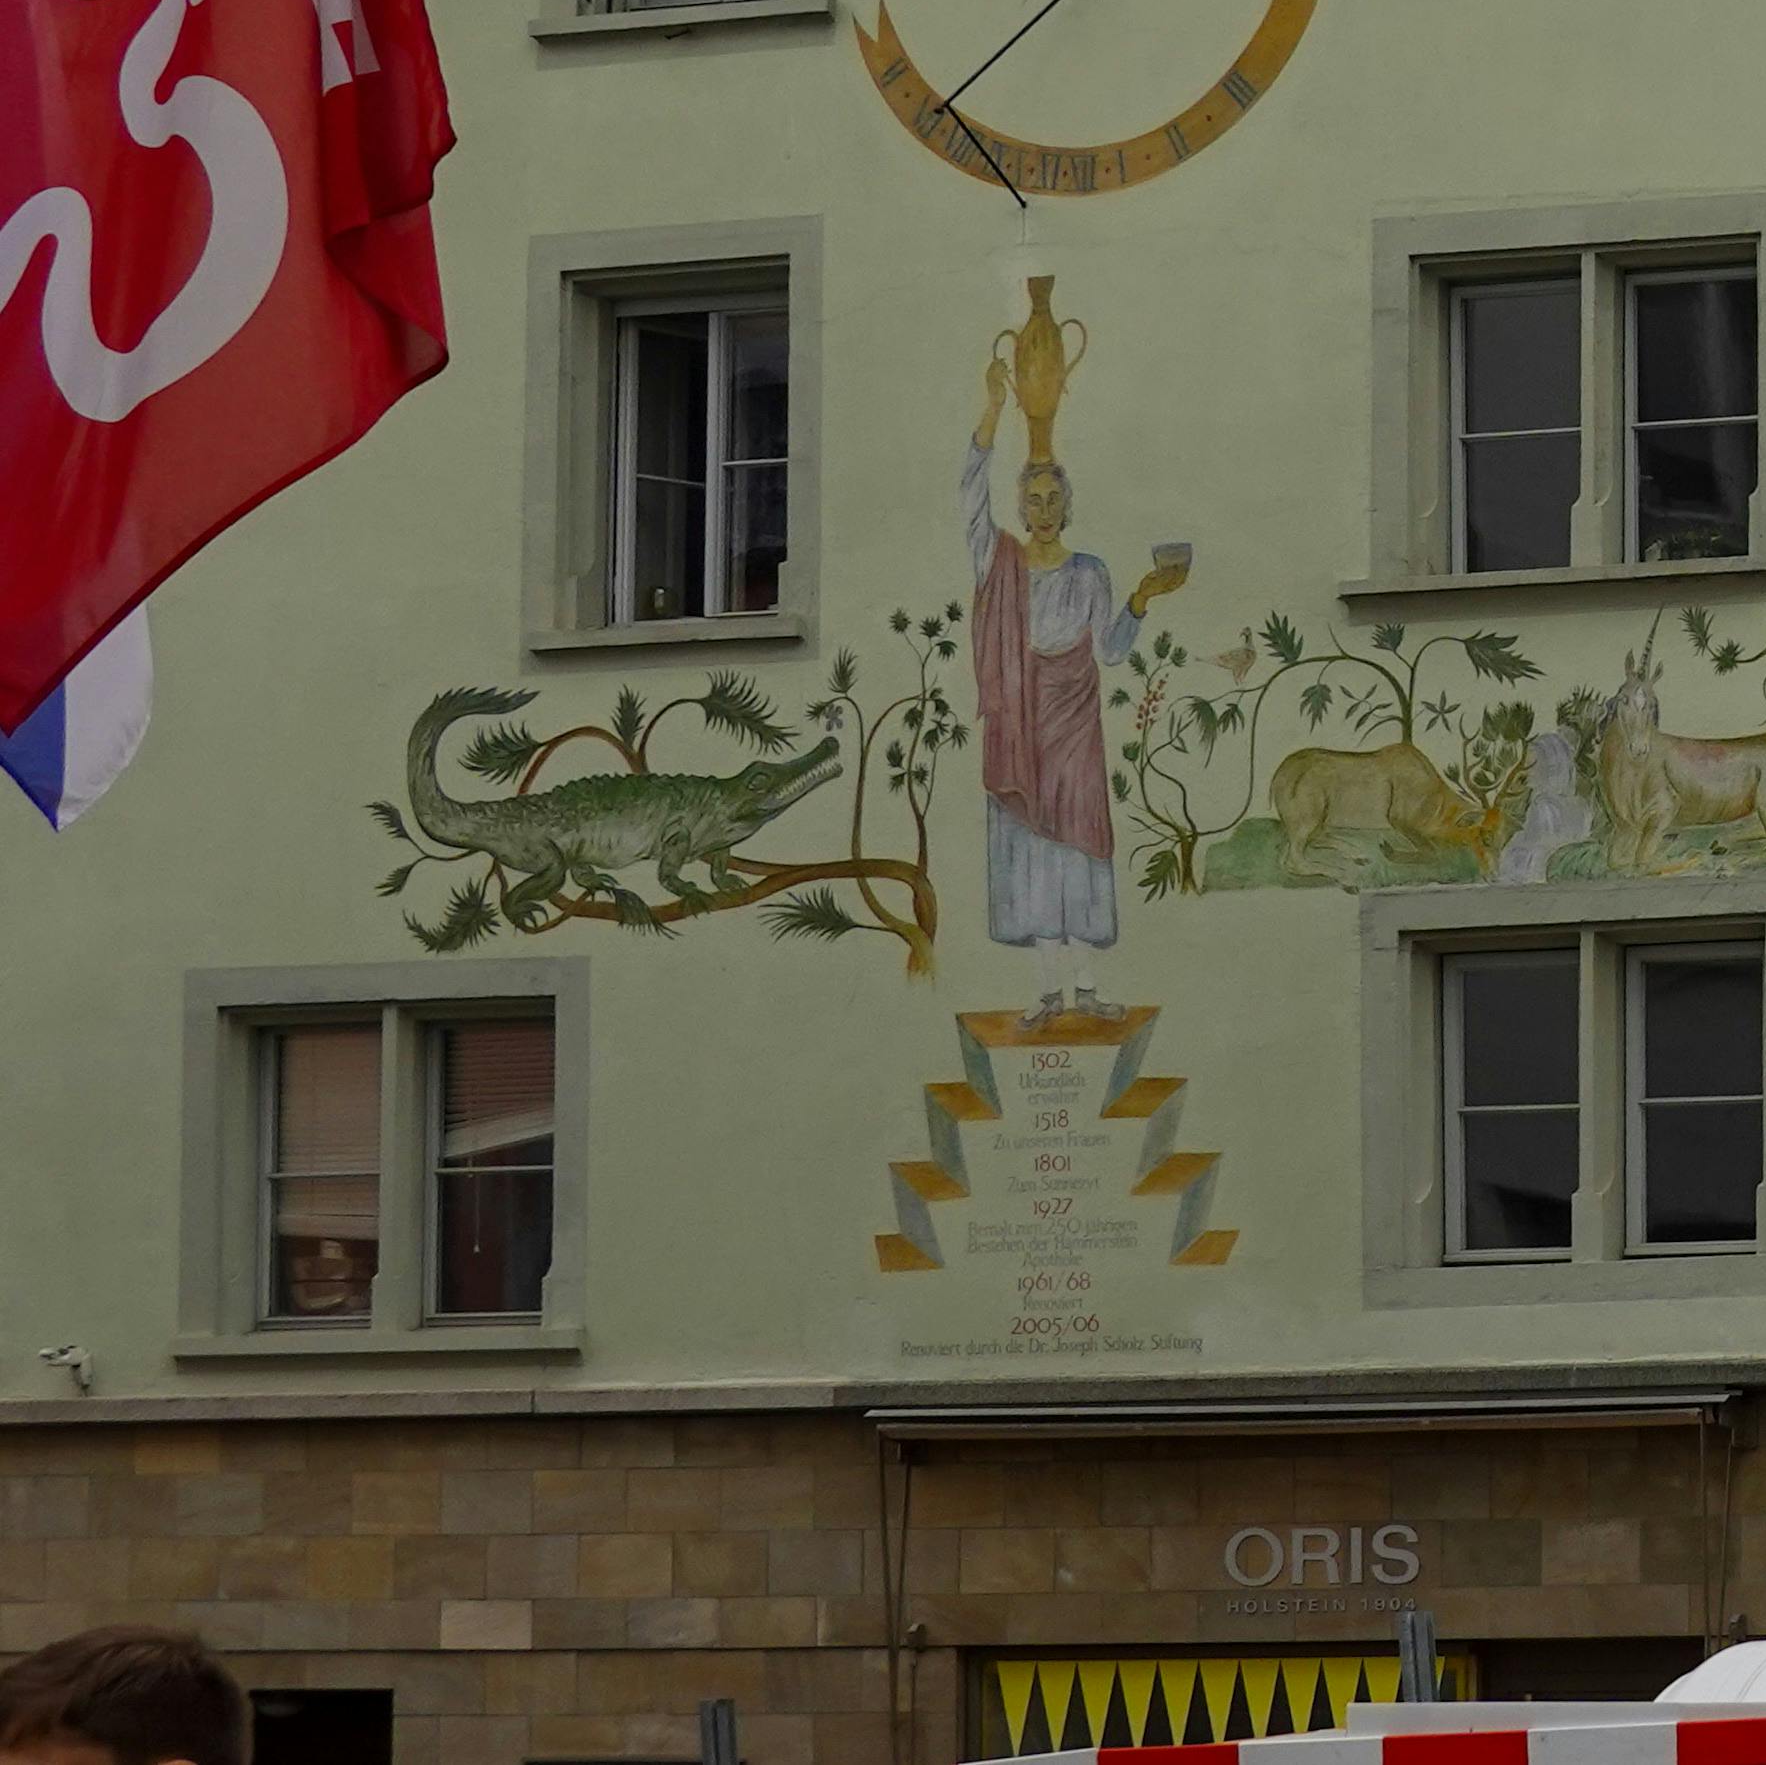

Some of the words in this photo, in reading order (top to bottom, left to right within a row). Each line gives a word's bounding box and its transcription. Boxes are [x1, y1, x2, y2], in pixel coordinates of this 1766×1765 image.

[1031, 1050, 1072, 1071] 1302
[1035, 1110, 1069, 1131] 1518
[1034, 1153, 1071, 1172] 1801
[1033, 1197, 1073, 1218] 1927
[1047, 1219, 1082, 1234] 250
[1011, 1314, 1100, 1336] 2005/06
[901, 1340, 960, 1357] Renoviert
[967, 1338, 1002, 1355] durch
[1053, 1335, 1099, 1355] Joseph
[1151, 1334, 1204, 1355] Stiftung
[1224, 1524, 1420, 1586] ORIS
[1361, 1597, 1417, 1612] 1904
